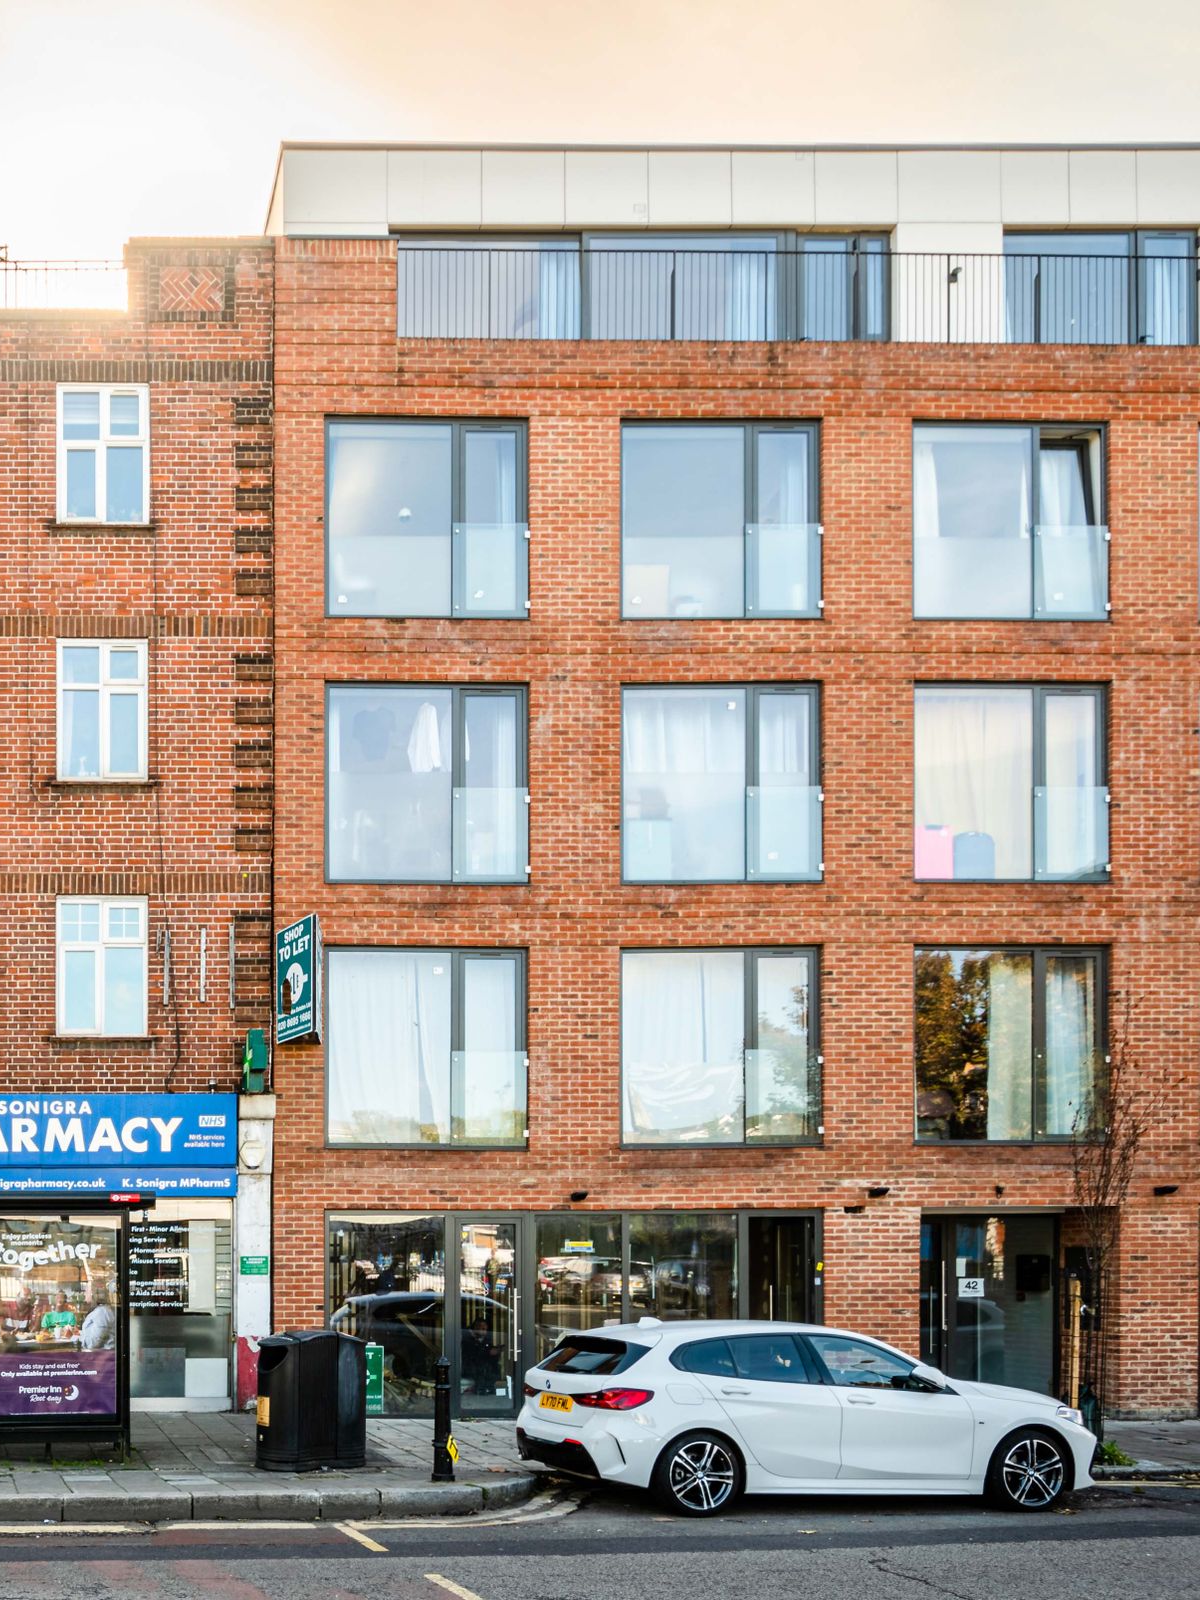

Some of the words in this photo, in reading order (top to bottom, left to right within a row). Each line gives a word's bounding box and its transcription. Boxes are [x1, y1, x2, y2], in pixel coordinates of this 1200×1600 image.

[284, 923, 304, 944] SHOP
[278, 945, 291, 962] TO
[292, 934, 310, 957] LET
[201, 1116, 224, 1126] NHS
[122, 1178, 133, 1188] K.
[136, 1178, 177, 1190] Sonigra
[180, 1178, 231, 1188] MPharmS
[1, 1233, 21, 1241] Enjoy
[965, 1280, 978, 1289] 42
[19, 1385, 48, 1394] Premier
[50, 1385, 62, 1393] Inn
